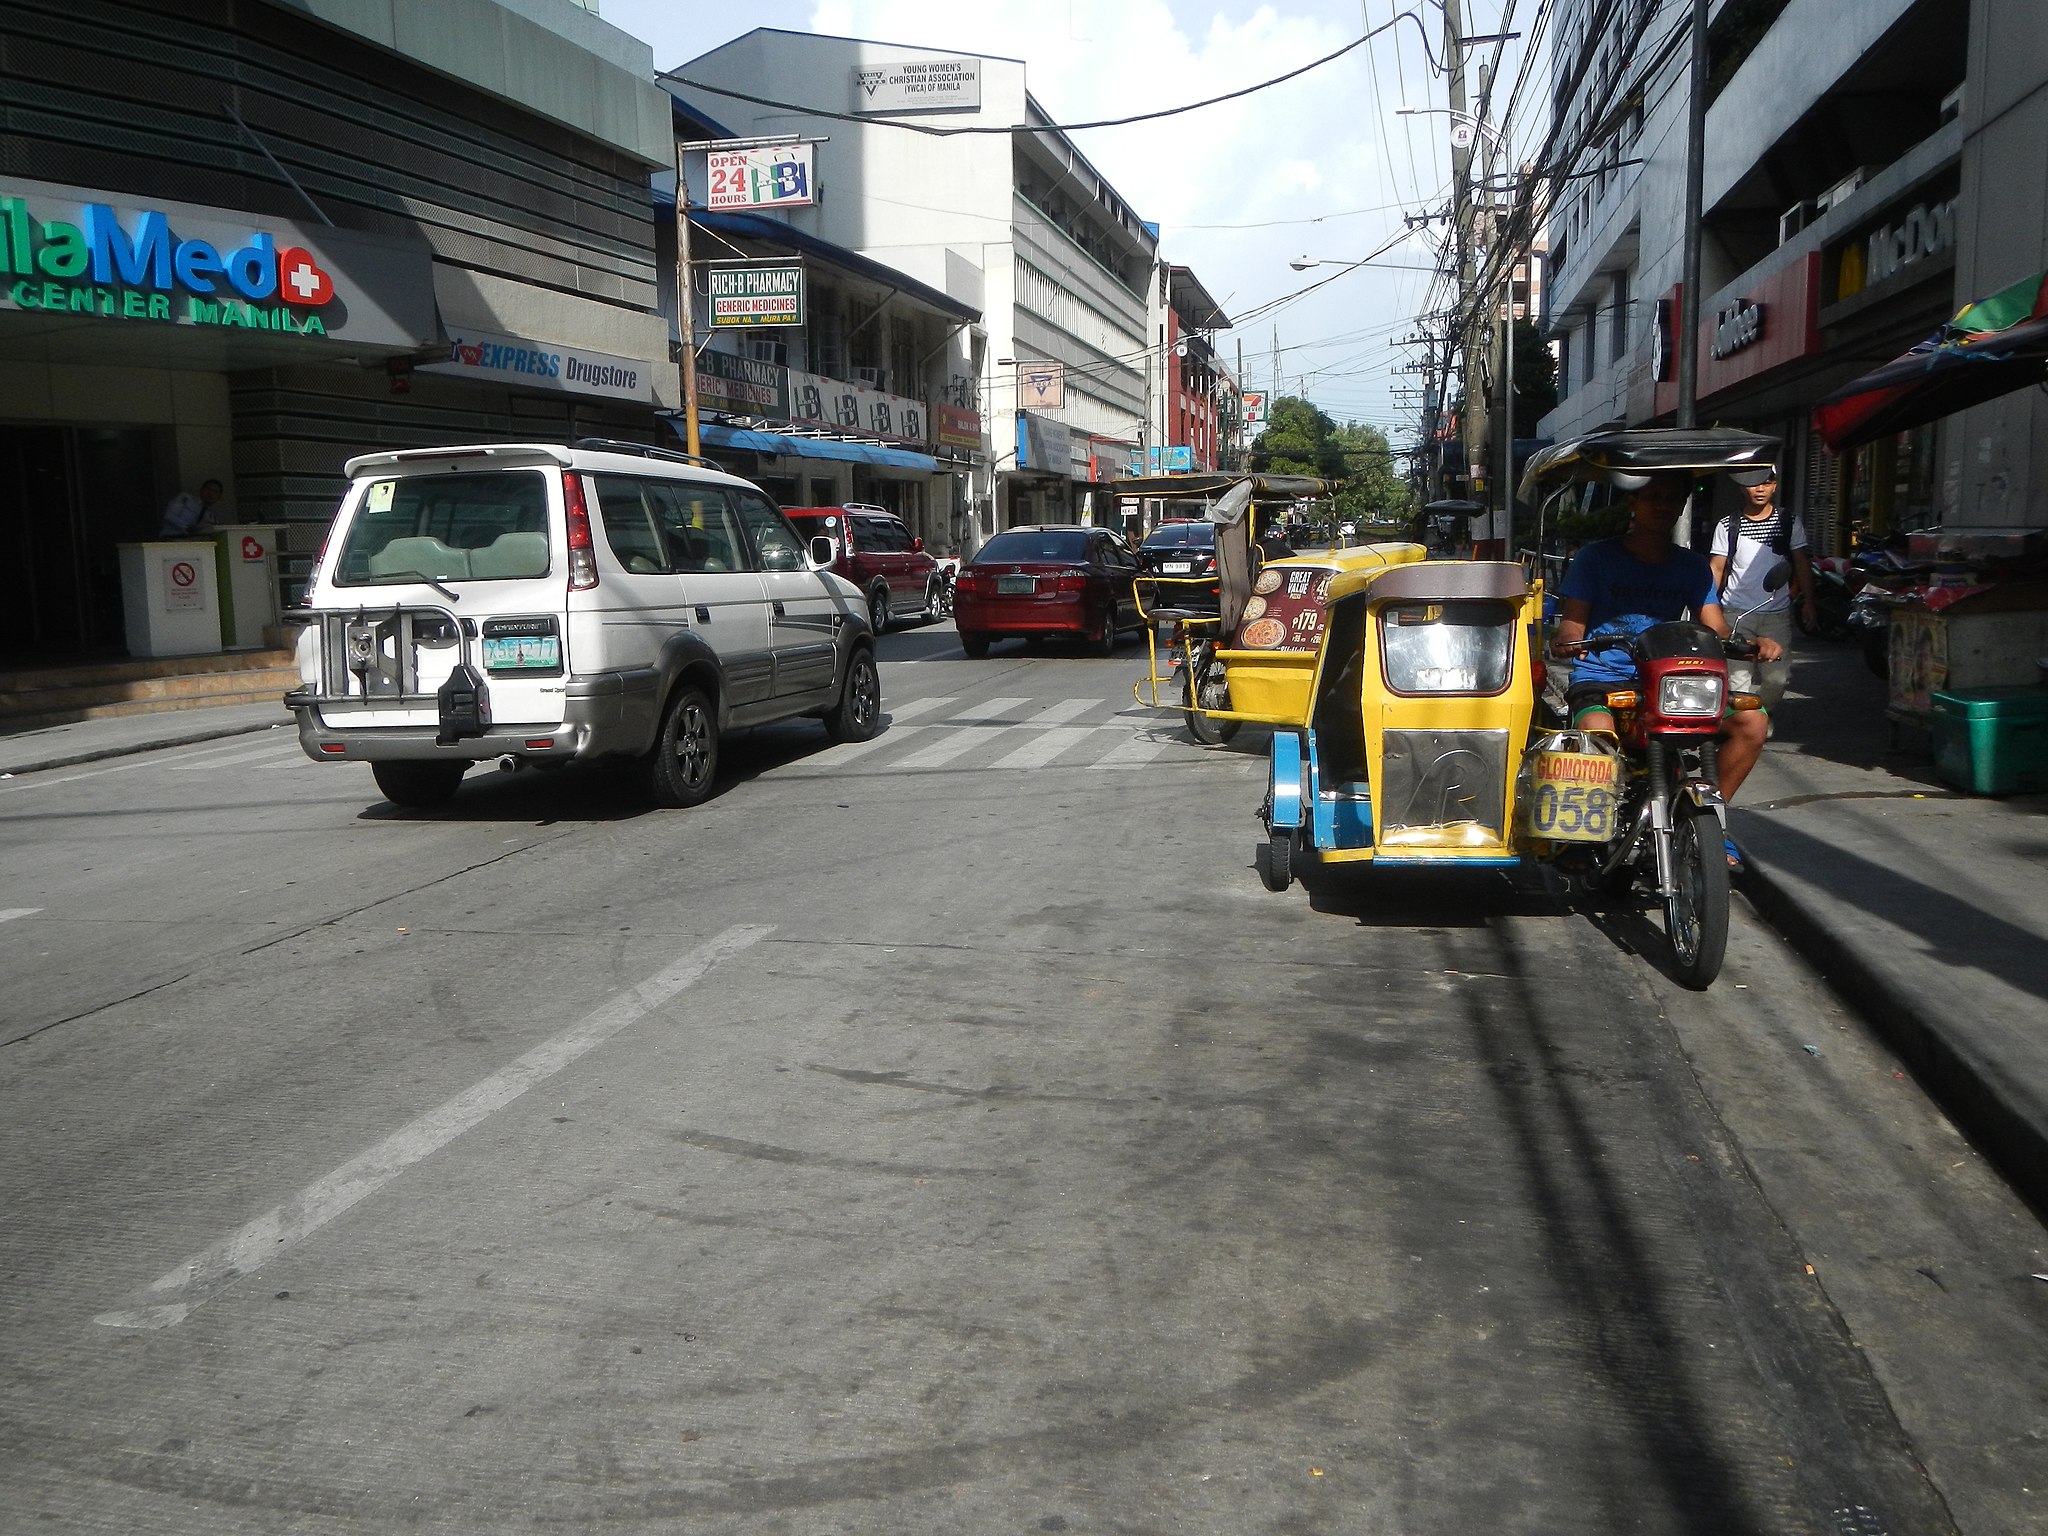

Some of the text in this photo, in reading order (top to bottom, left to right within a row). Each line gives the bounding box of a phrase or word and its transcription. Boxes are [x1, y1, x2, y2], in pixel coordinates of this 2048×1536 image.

[903, 63, 961, 74] YOUNG WOMEN'S
[889, 75, 927, 85] CHRISTIAN
[929, 72, 975, 83] ASSOCIATION
[904, 83, 961, 95] (YWCA) OF MANILA
[710, 156, 748, 168] OPEN
[711, 168, 746, 194] 24
[711, 195, 747, 204] HOURS
[747, 271, 799, 293] PHARMACY
[12, 281, 326, 336] CENTER MANILA
[716, 298, 796, 313] GENERIC MEDICINES
[760, 314, 781, 323] MURA
[479, 342, 561, 378] EXPRESS
[566, 356, 638, 389] Drugstore
[721, 355, 779, 387] PHARMACY
[726, 380, 771, 404] MEDICINES
[1243, 395, 1262, 406] 7
[1290, 571, 1312, 583] GREAT
[1287, 582, 1308, 594] VALUE
[1536, 756, 1613, 785] GLOMOTODA
[1534, 784, 1608, 836] 058
